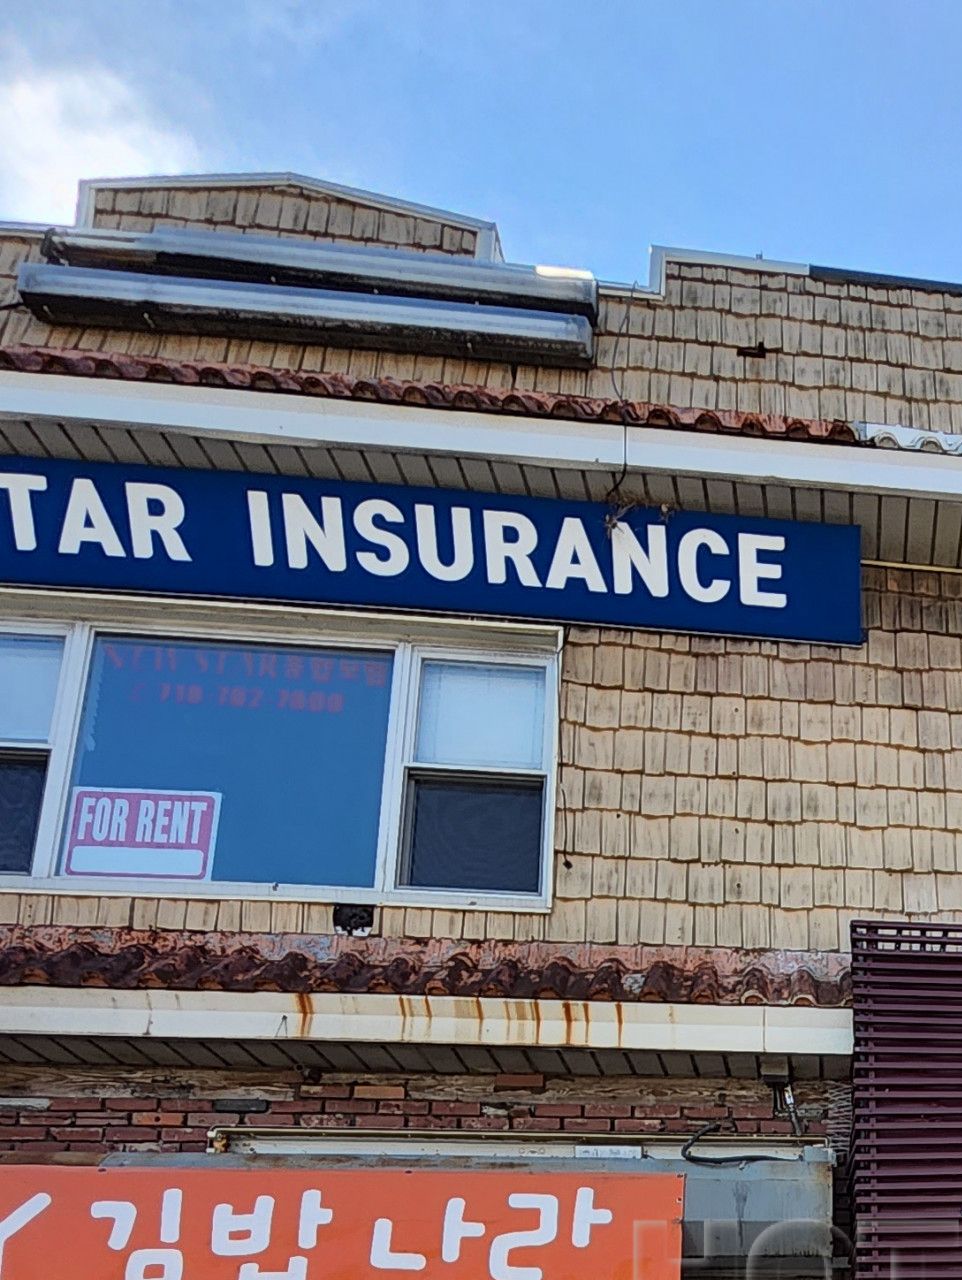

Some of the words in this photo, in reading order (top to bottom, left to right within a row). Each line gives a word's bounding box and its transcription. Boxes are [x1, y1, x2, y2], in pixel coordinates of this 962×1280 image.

[246, 488, 788, 609] INSURANCE
[77, 796, 129, 842] FOR
[135, 799, 207, 844] RENT
